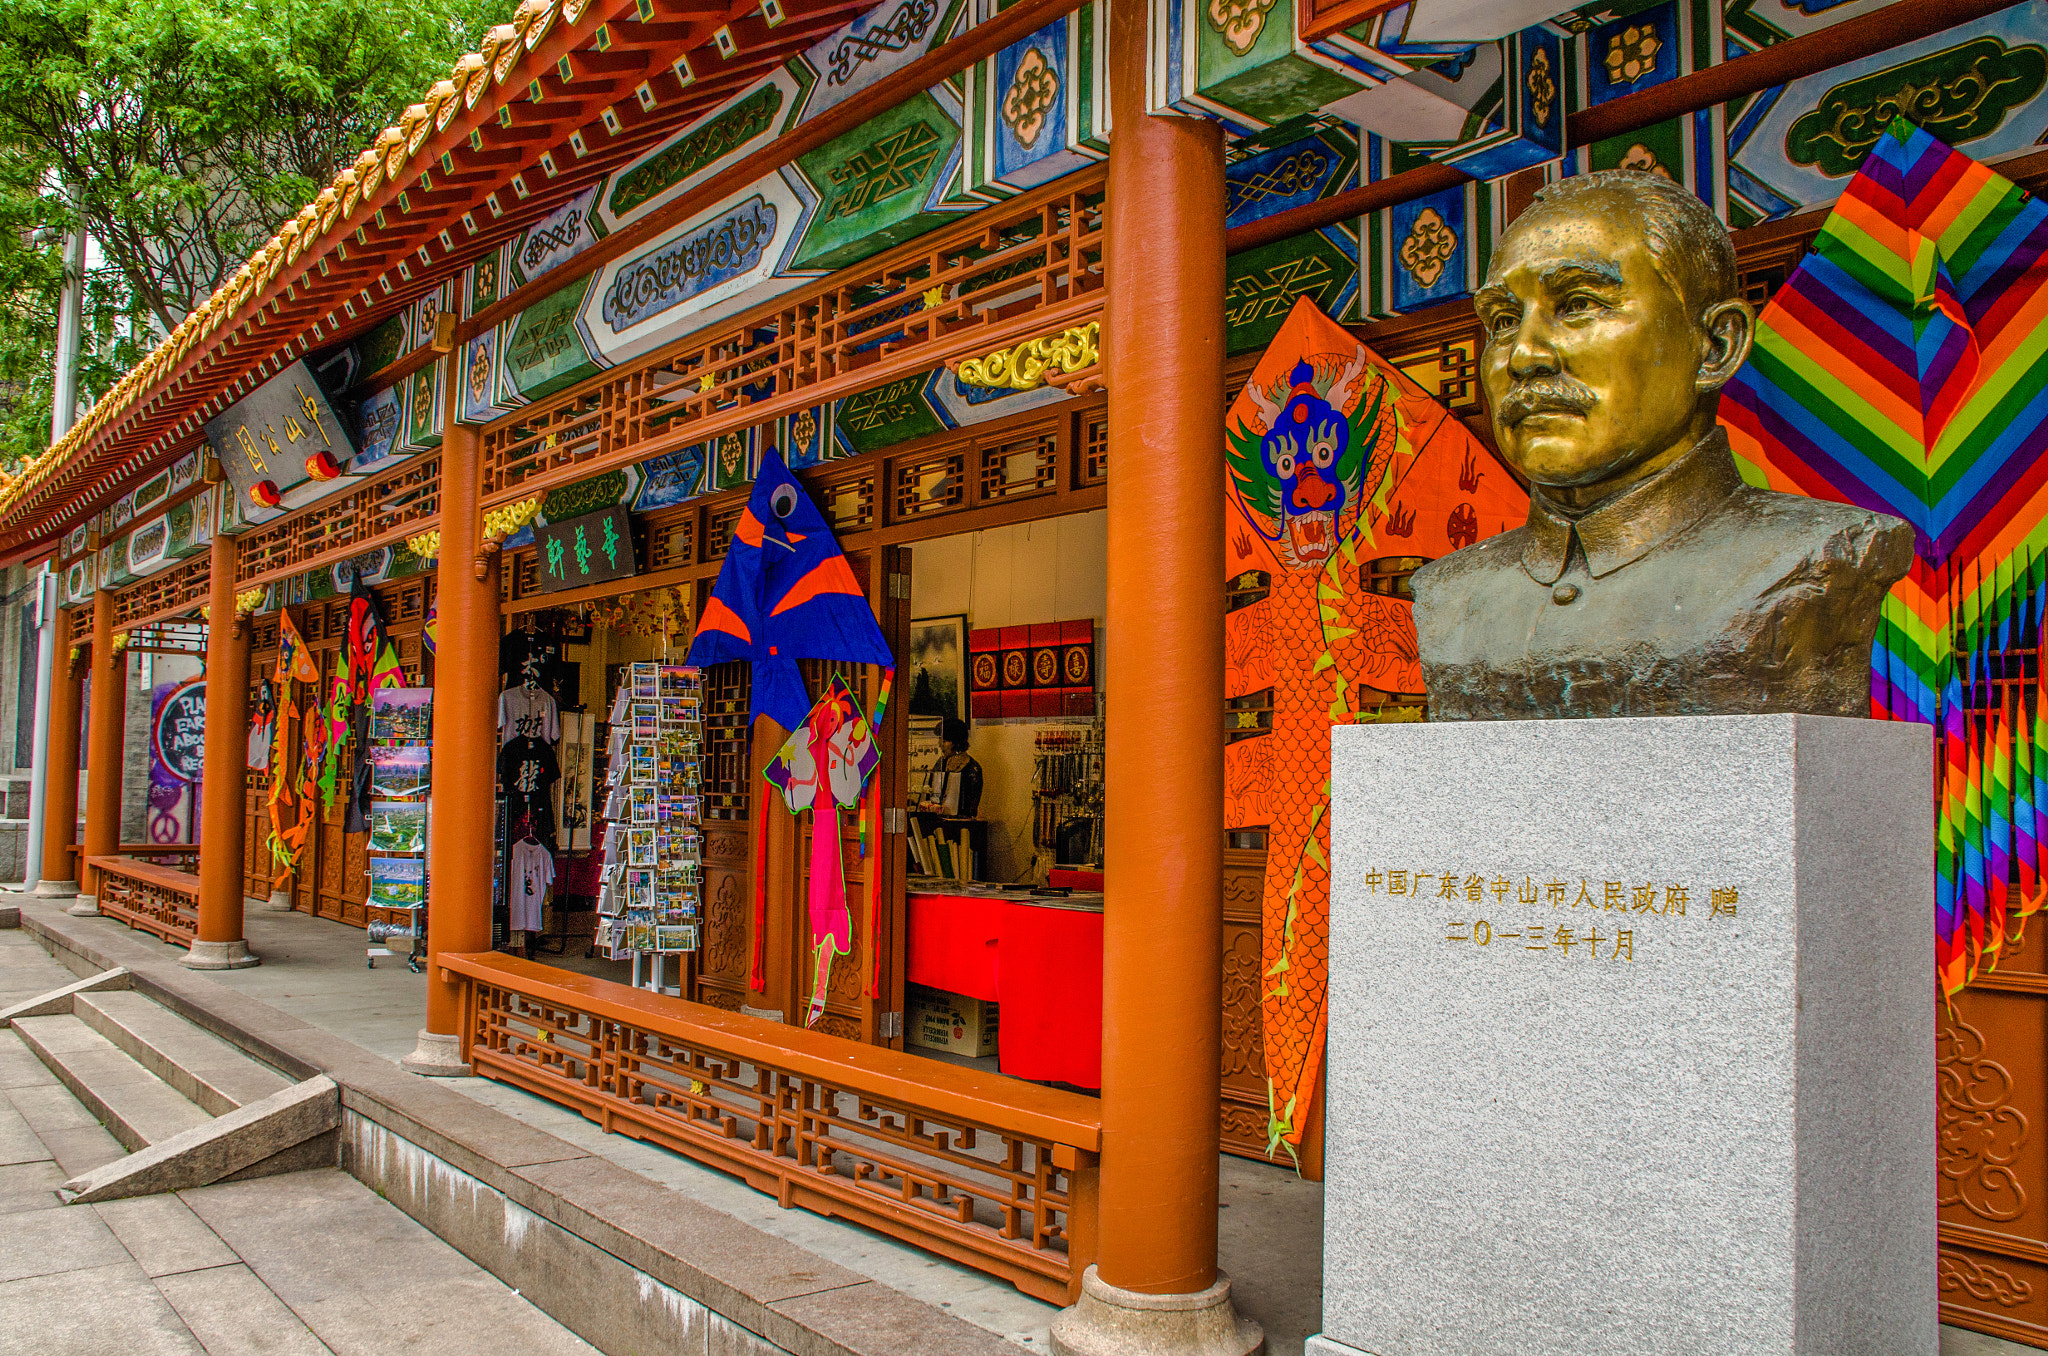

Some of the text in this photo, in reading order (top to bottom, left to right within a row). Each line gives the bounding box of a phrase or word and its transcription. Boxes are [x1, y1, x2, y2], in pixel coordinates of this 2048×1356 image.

[1365, 867, 1739, 920] 中国广东省中山市人民政府 赠
